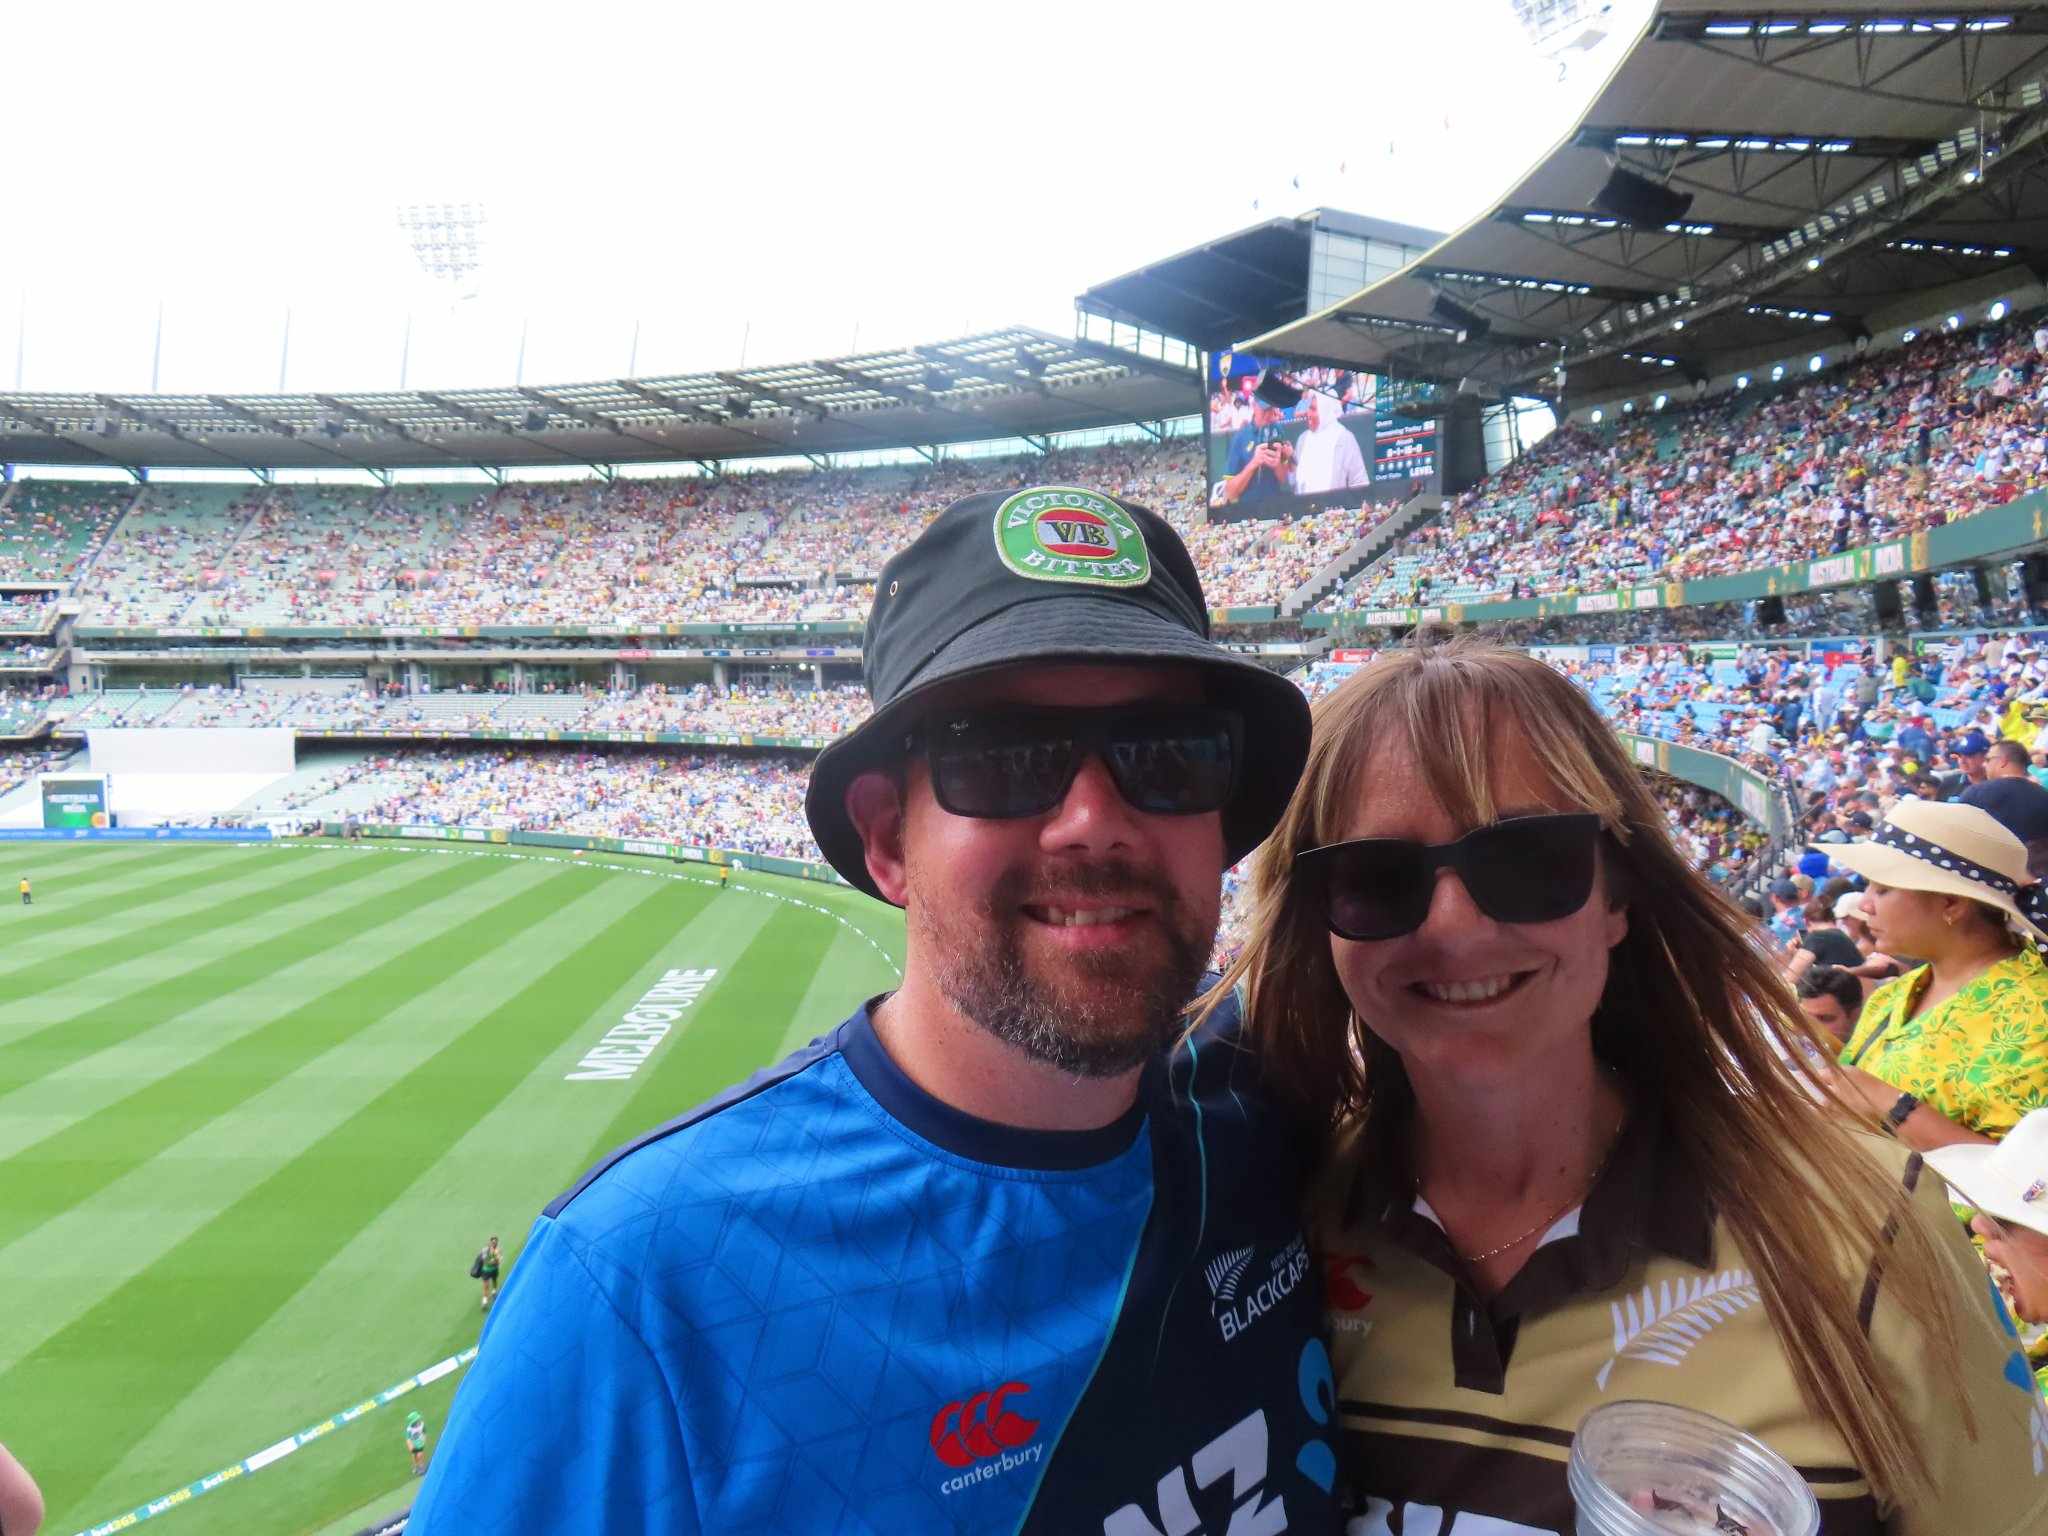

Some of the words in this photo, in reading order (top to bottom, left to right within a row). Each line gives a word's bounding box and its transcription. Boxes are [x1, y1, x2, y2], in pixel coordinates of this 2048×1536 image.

[1409, 465, 1435, 478] LEVEL
[1007, 492, 1134, 540] VICTORIA
[1045, 520, 1110, 547] VB
[1022, 548, 1142, 578] BITTER
[563, 968, 718, 1081] MELBOURNE
[1219, 1250, 1310, 1342] BLACKCAPS
[202, 1464, 243, 1490] bet365
[940, 1443, 1043, 1495] canterbury
[1102, 1408, 1289, 1536] NZ
[148, 1487, 192, 1515] bet365
[91, 1512, 138, 1536] bet365
